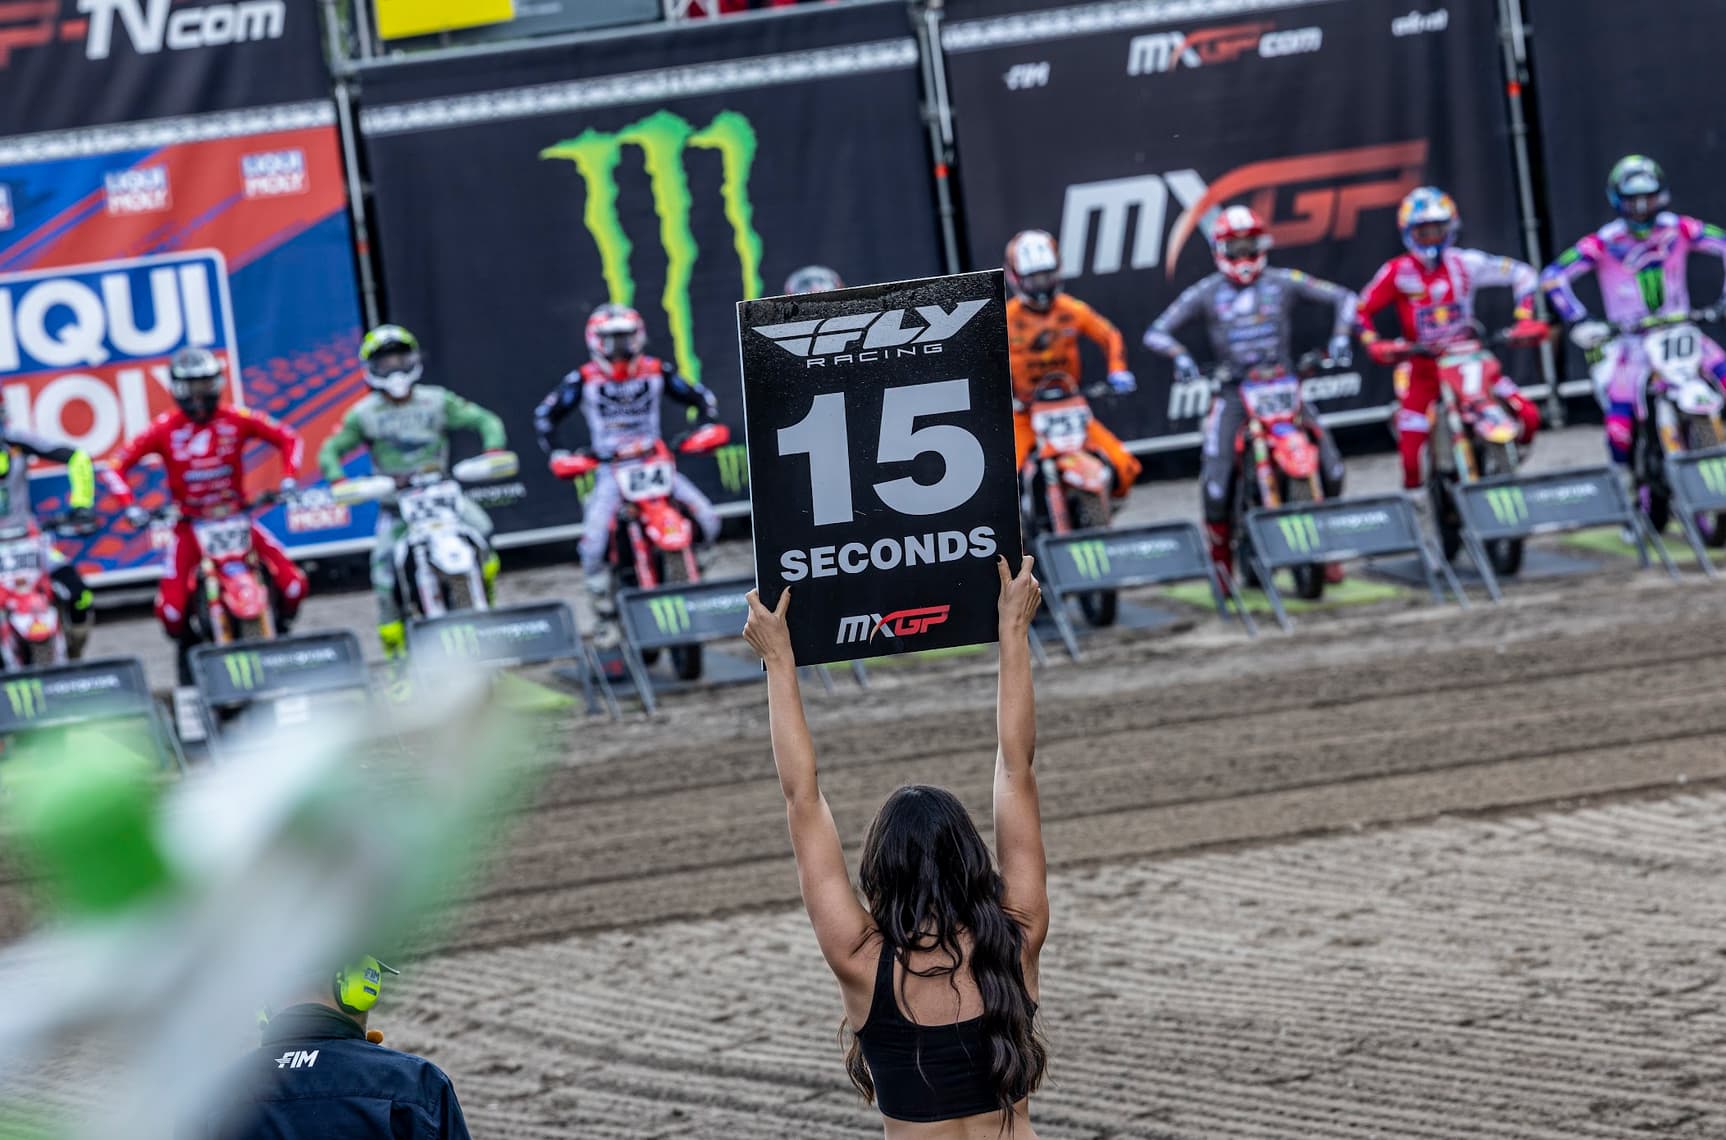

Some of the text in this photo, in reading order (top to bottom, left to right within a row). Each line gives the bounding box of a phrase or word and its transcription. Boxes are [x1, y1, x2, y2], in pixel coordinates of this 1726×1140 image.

[751, 298, 991, 357] FLY
[806, 342, 943, 369] RACING
[1661, 335, 1693, 361] 10
[1458, 361, 1482, 394] 1
[777, 378, 986, 526] 15
[780, 526, 997, 582] SECONDS
[836, 604, 950, 645] MXGP
[274, 1050, 319, 1069] FIM
